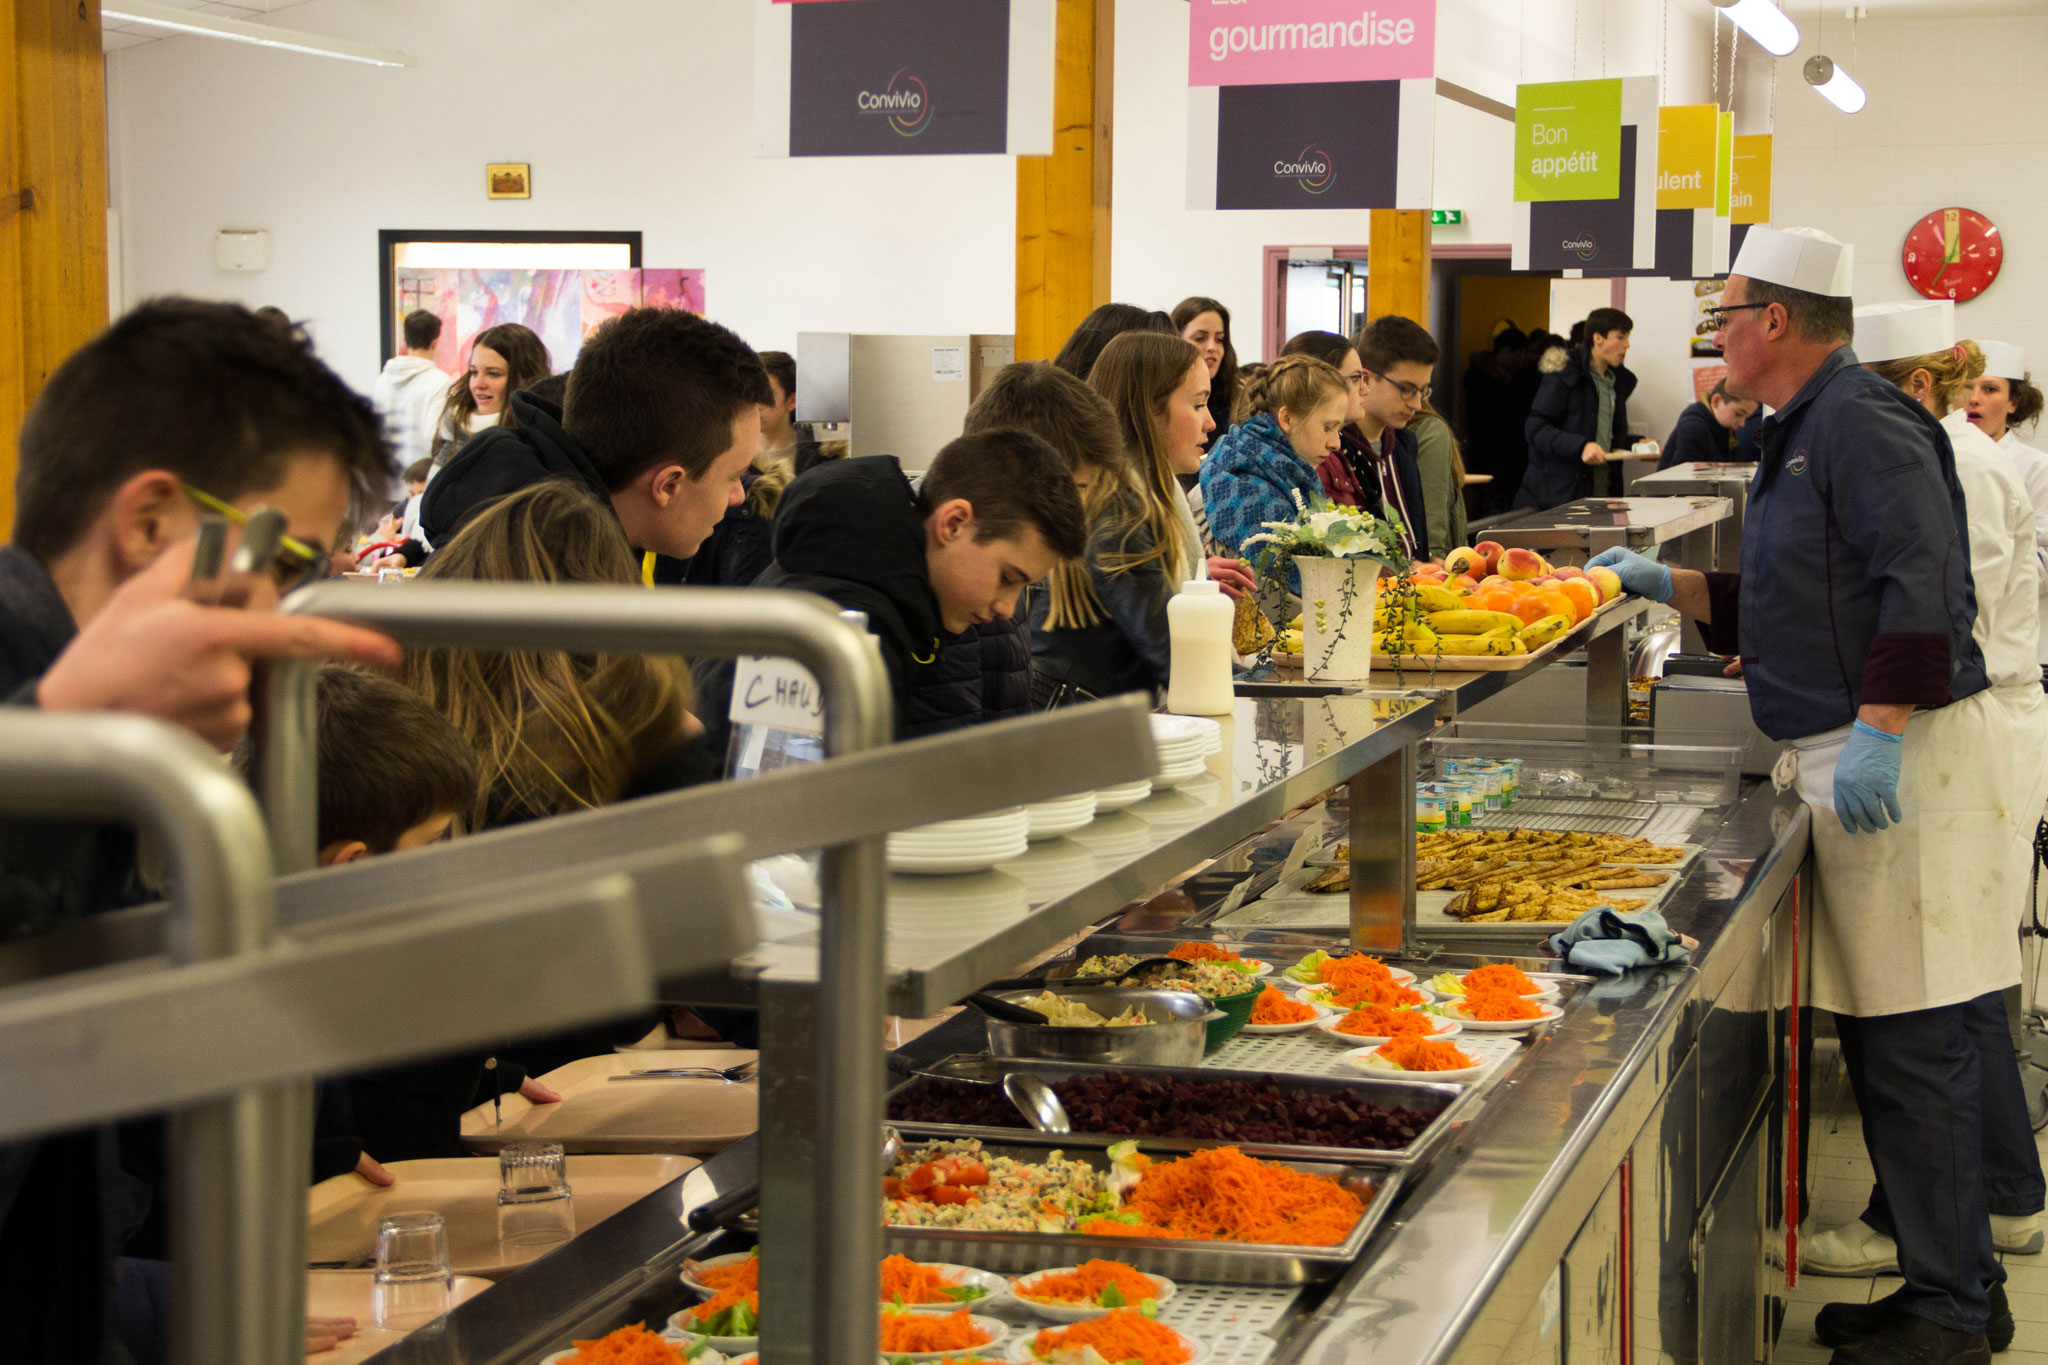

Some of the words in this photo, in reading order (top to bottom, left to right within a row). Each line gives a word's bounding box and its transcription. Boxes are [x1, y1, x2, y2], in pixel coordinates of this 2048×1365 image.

[1209, 11, 1415, 61] gourmandise
[1532, 123, 1568, 145] Bon
[1531, 150, 1599, 179] appétit
[1945, 212, 1957, 222] 12
[1908, 252, 1916, 263] 9
[1989, 247, 1997, 257] 3
[1948, 288, 1957, 298] 6
